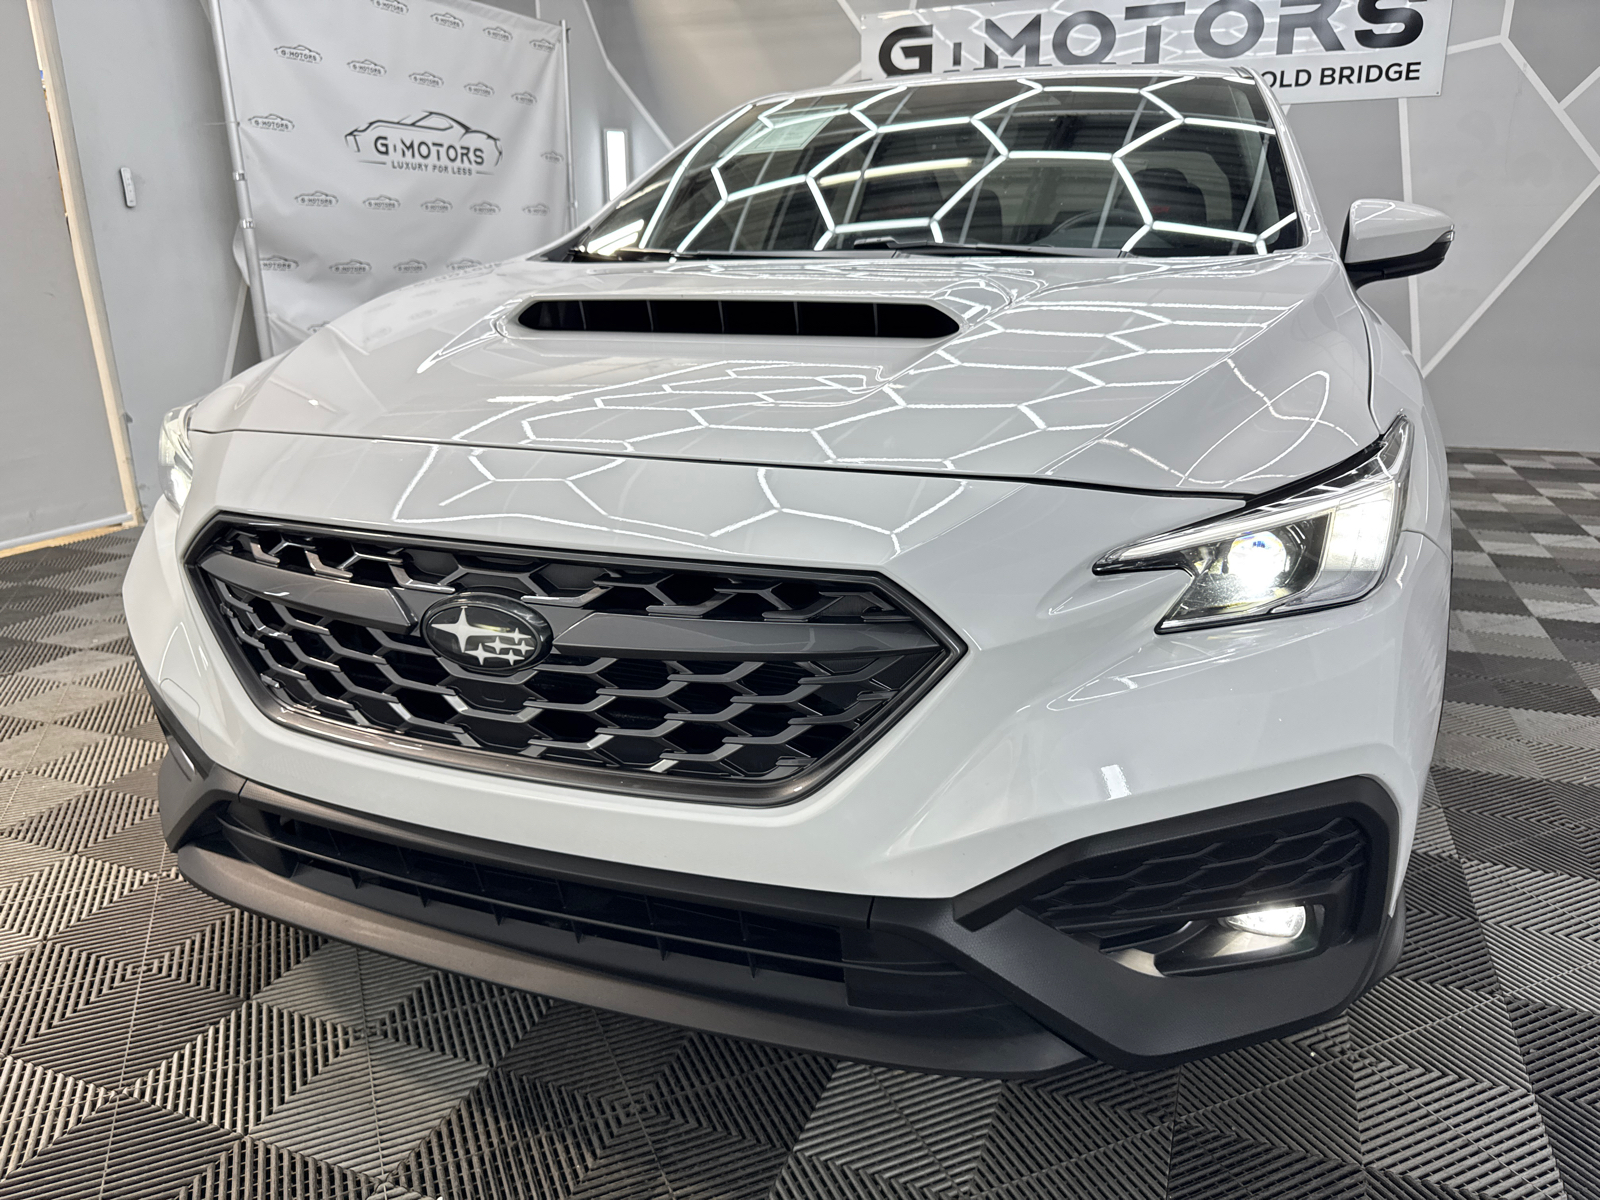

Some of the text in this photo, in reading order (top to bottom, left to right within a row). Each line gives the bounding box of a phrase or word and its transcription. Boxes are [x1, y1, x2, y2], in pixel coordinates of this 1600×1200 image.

[1261, 61, 1422, 89] OLD BRIDGE
[391, 160, 473, 177] LUXURY FOR LESS
